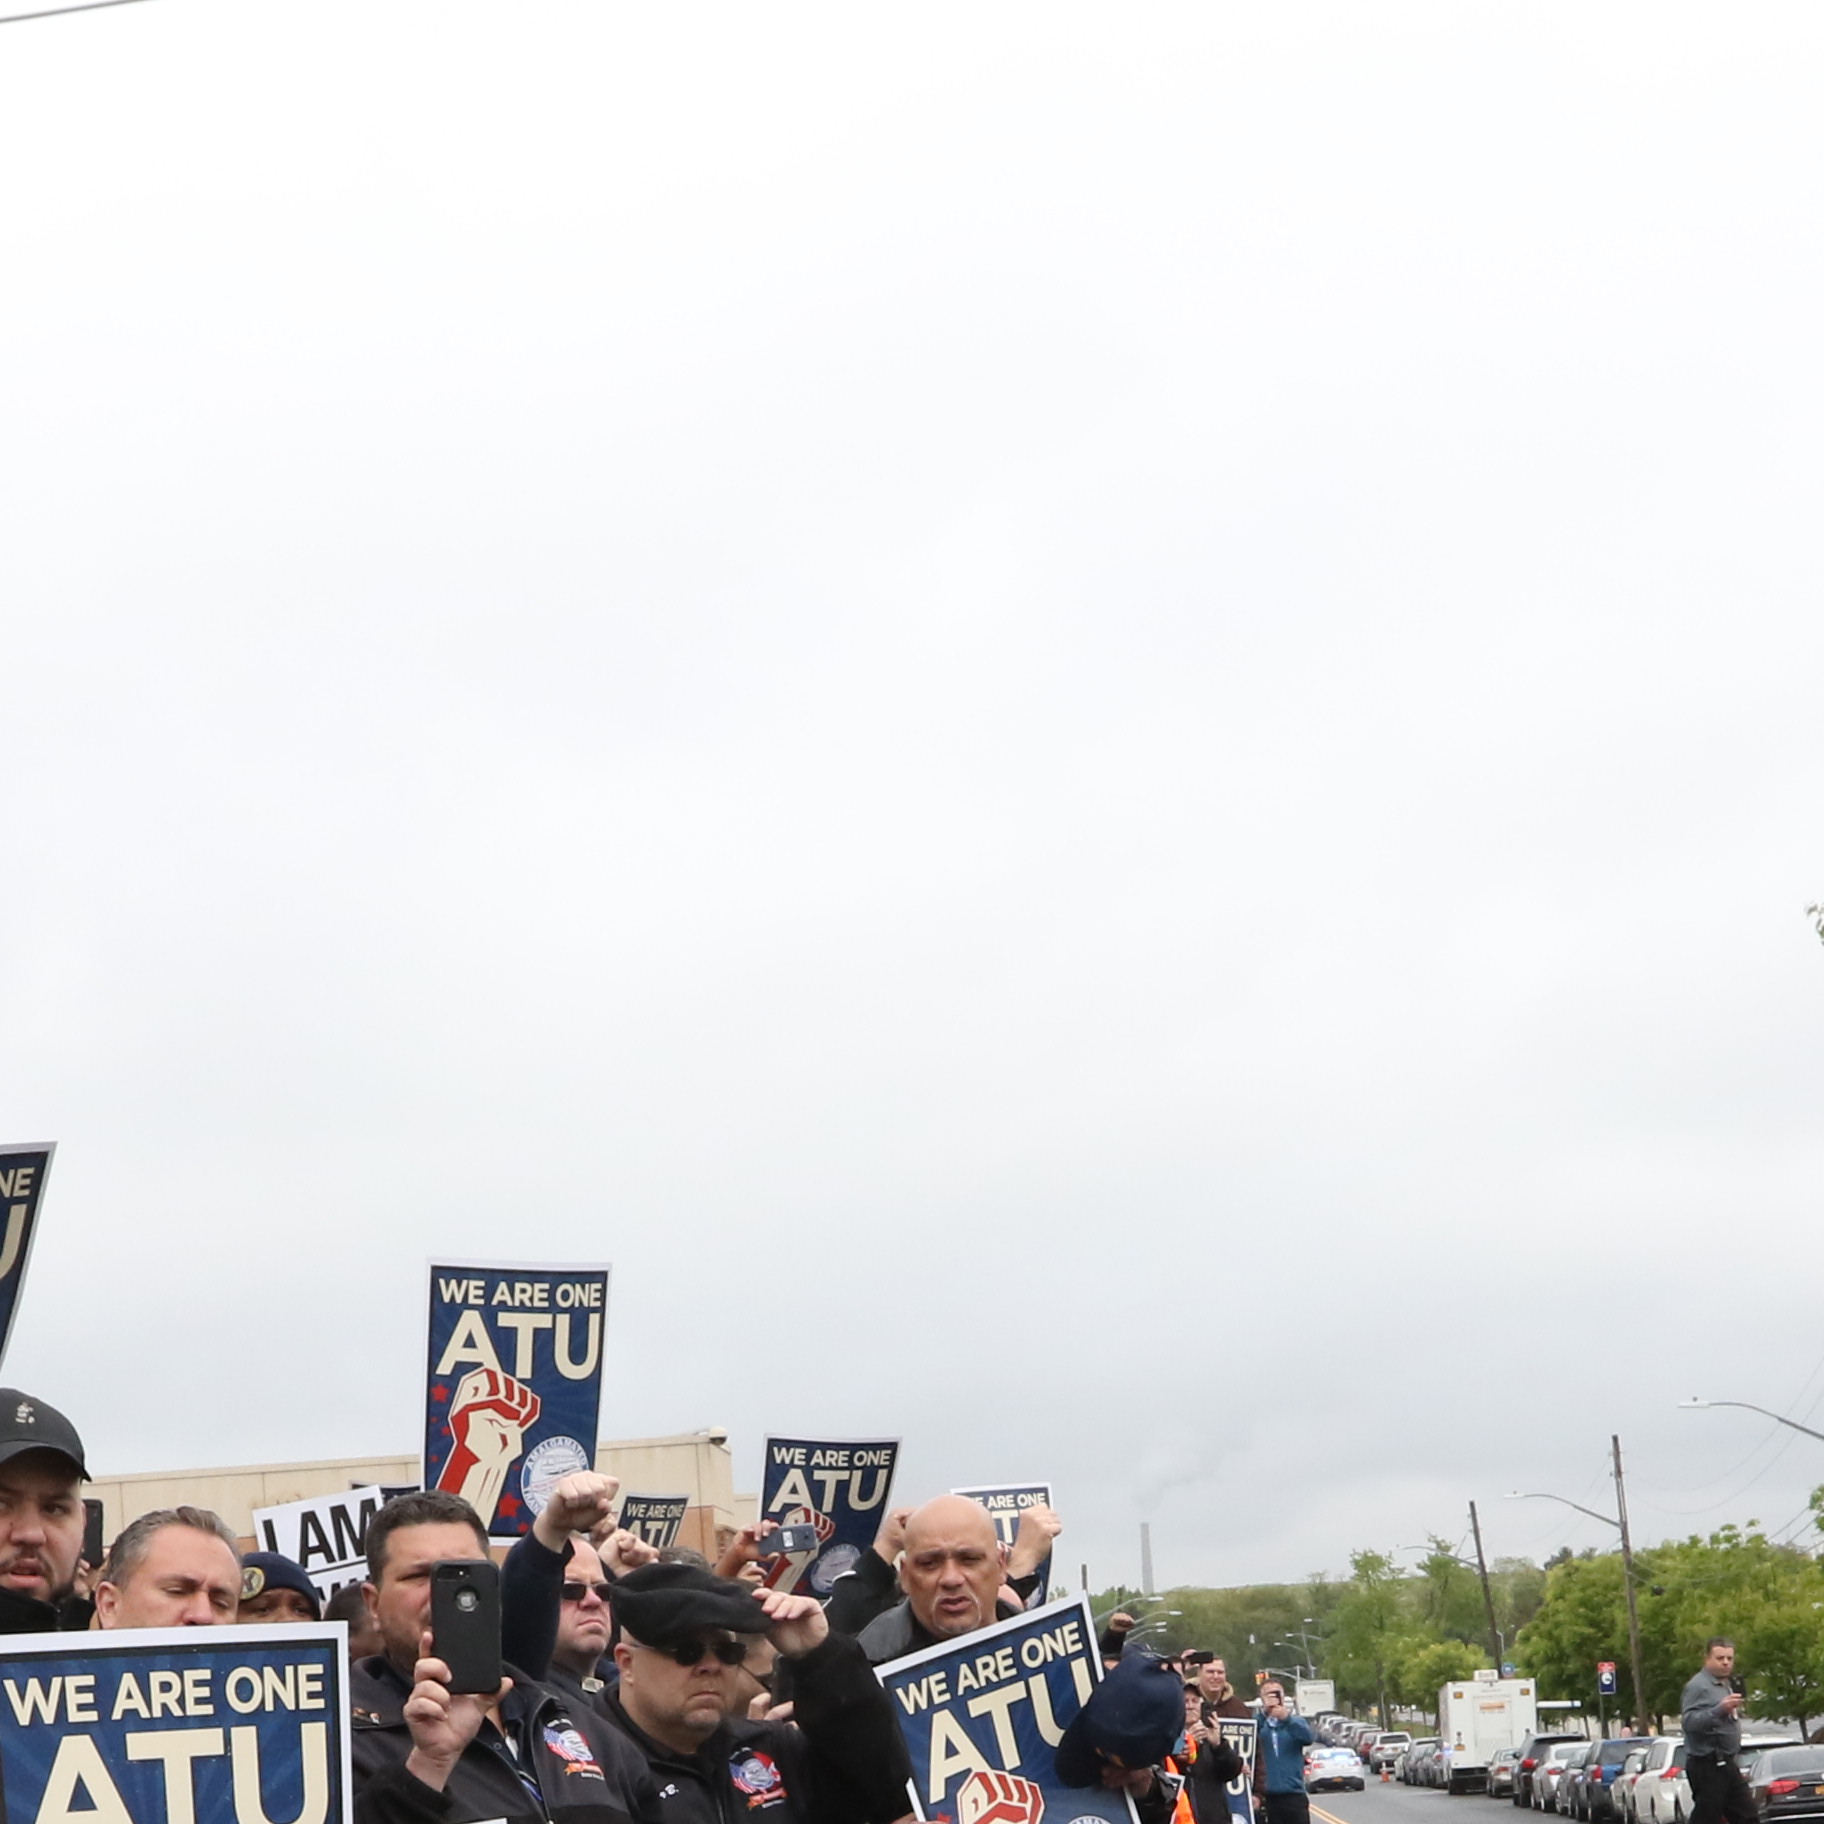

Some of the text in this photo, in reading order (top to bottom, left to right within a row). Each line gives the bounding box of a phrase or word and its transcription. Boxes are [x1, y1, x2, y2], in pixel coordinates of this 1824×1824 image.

[439, 1278, 602, 1308] WE ARE ONE
[435, 1309, 601, 1381] ATU
[773, 1446, 892, 1467] WE ARE ONE
[626, 1503, 684, 1518] WE ARE ONE
[767, 1468, 888, 1513] ATU
[987, 1494, 1015, 1509] ARE
[300, 1497, 377, 1569] AM
[3, 1663, 326, 1726] WE ARE ONE
[896, 1621, 1083, 1715] WE ARE ONE
[930, 1657, 1093, 1804] ATU
